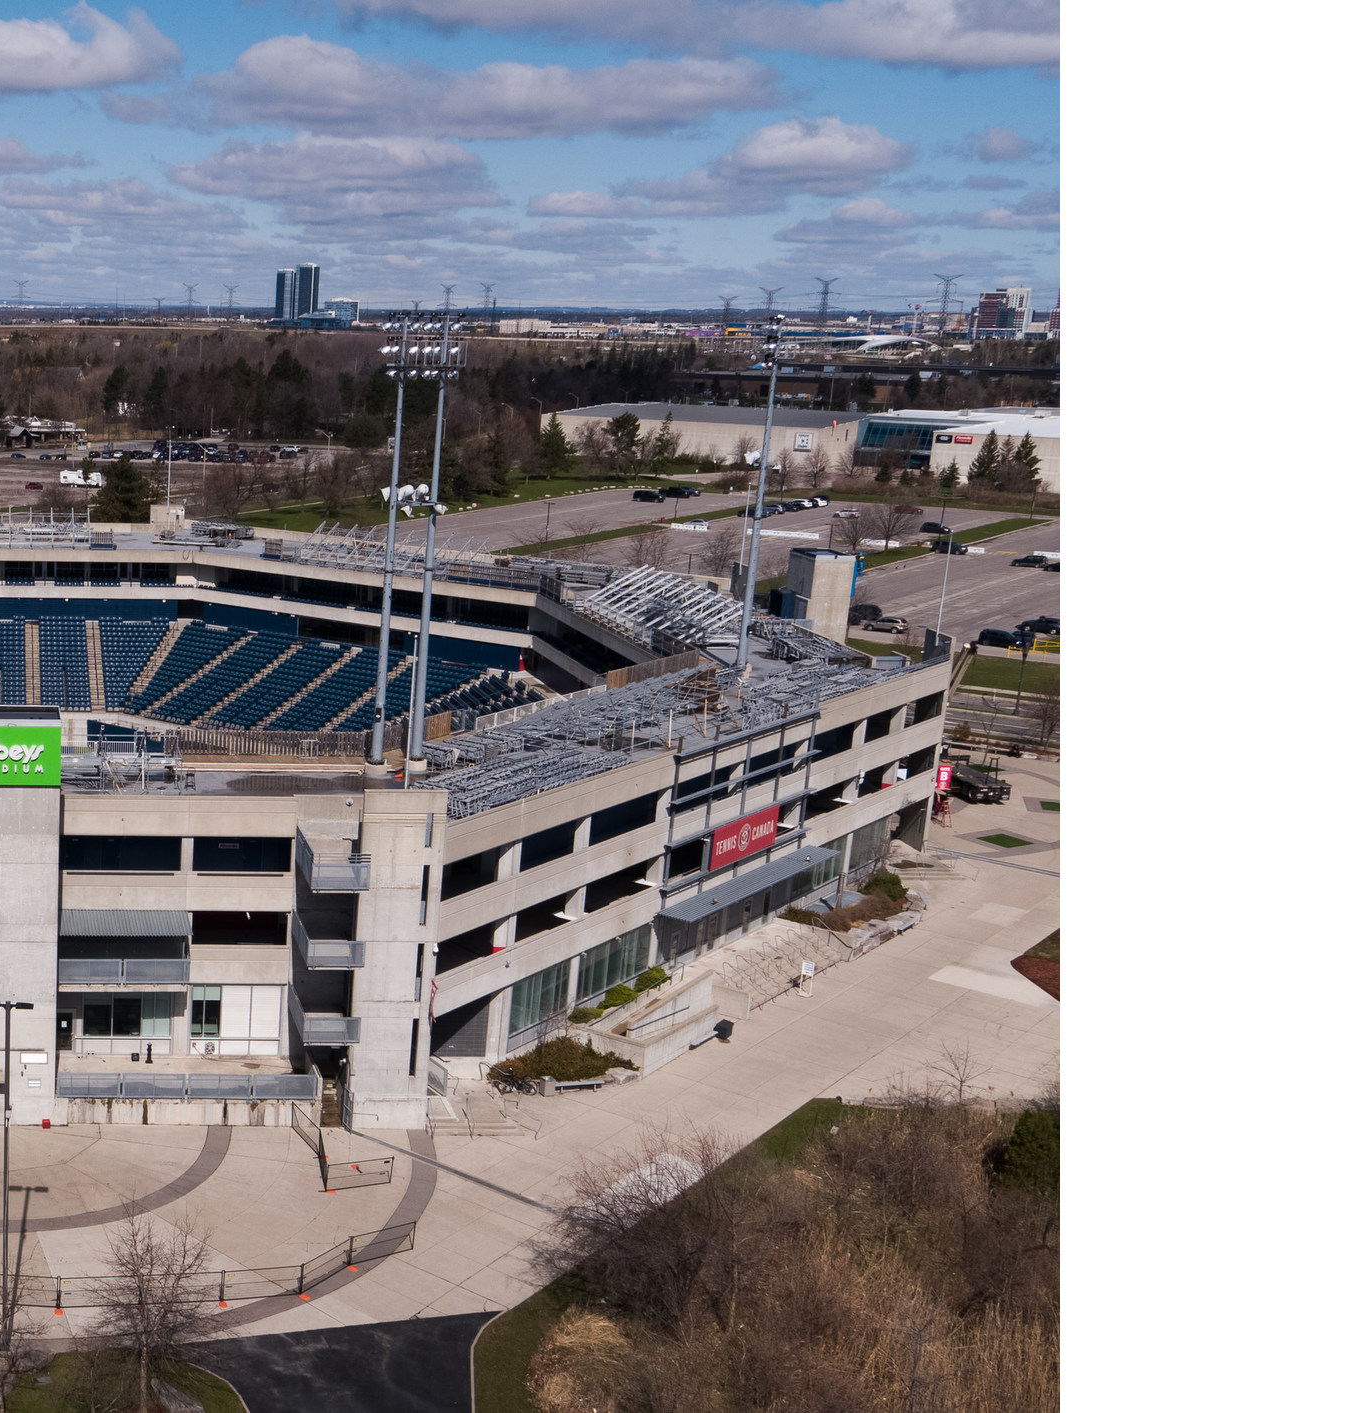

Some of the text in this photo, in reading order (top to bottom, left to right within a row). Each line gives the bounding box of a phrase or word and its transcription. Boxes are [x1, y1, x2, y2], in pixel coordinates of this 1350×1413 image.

[940, 772, 948, 780] B
[715, 836, 738, 856] TENNIS
[752, 820, 774, 840] CANADA
